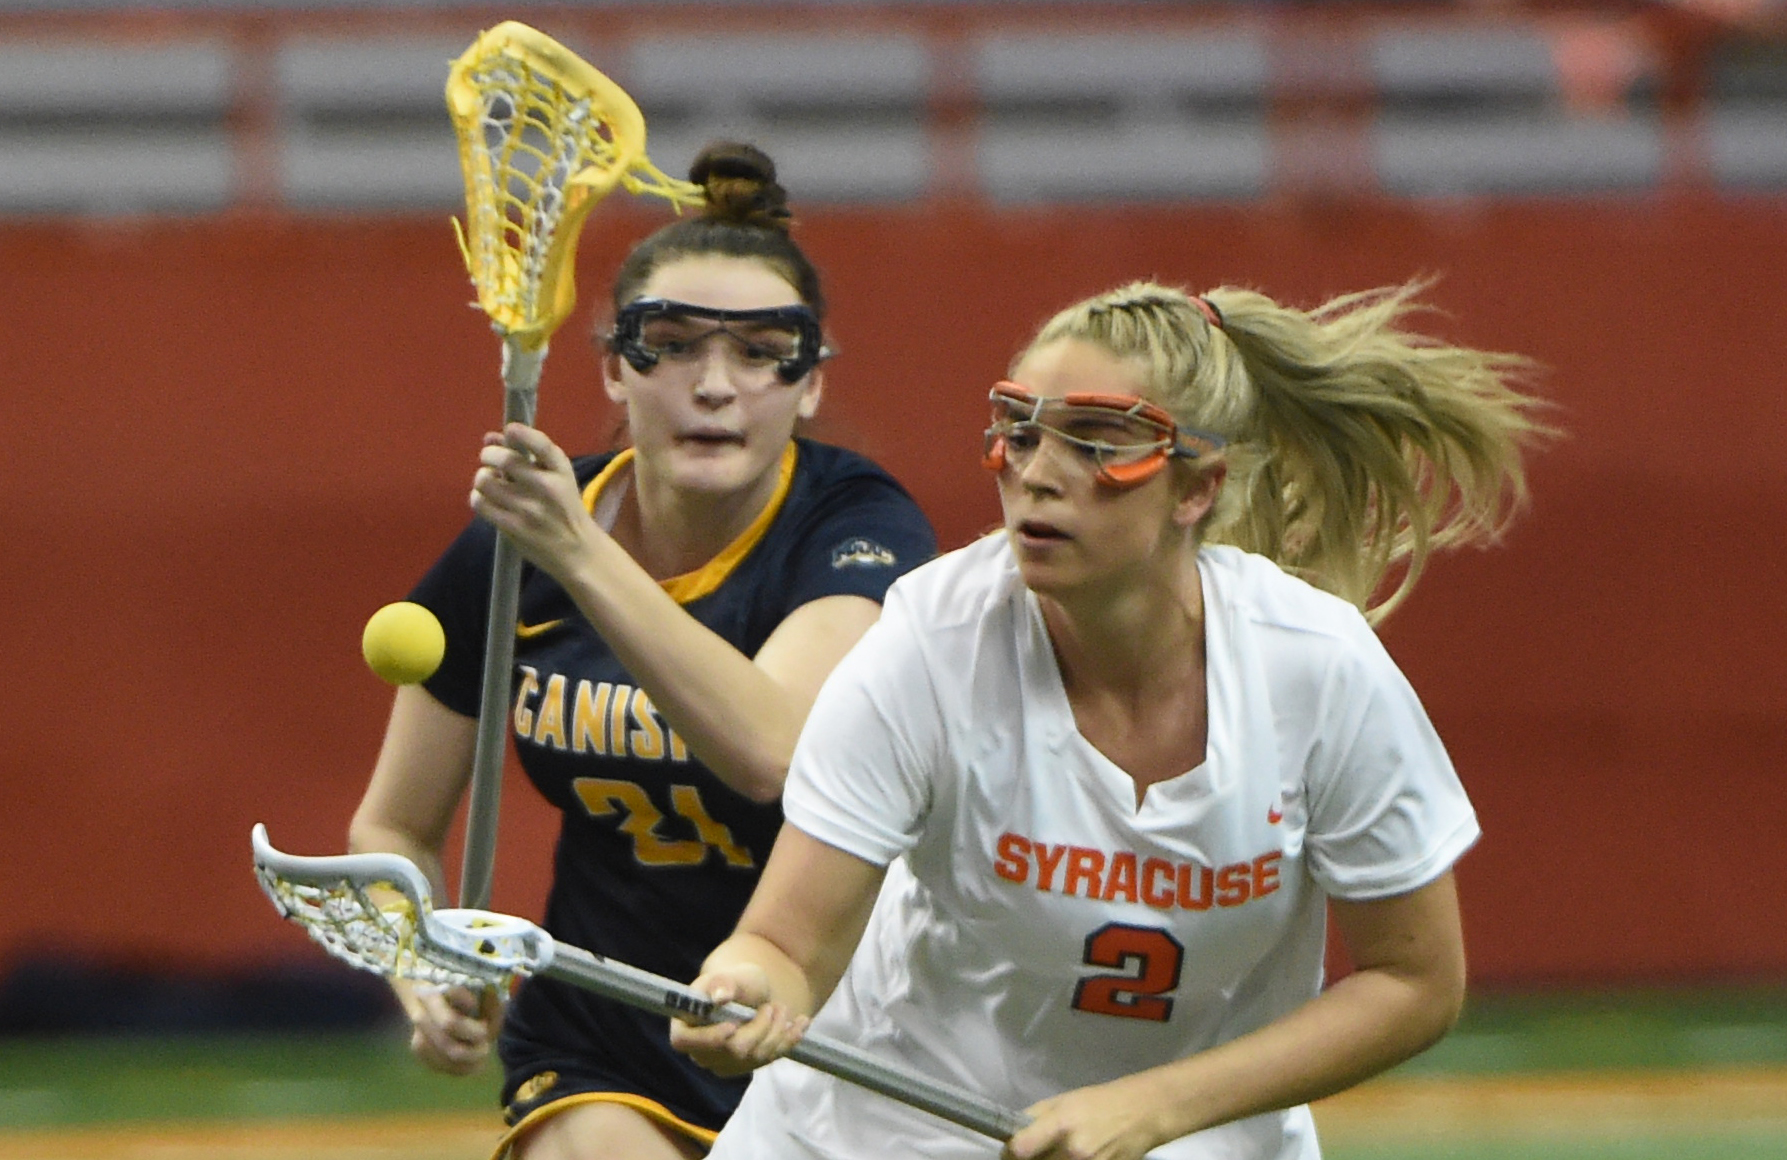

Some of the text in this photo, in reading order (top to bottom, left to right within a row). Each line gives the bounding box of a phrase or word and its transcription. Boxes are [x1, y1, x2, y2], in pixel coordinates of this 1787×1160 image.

[573, 776, 754, 868] 21
[994, 832, 1282, 911] SYRACUSE
[1071, 920, 1185, 1023] 2
